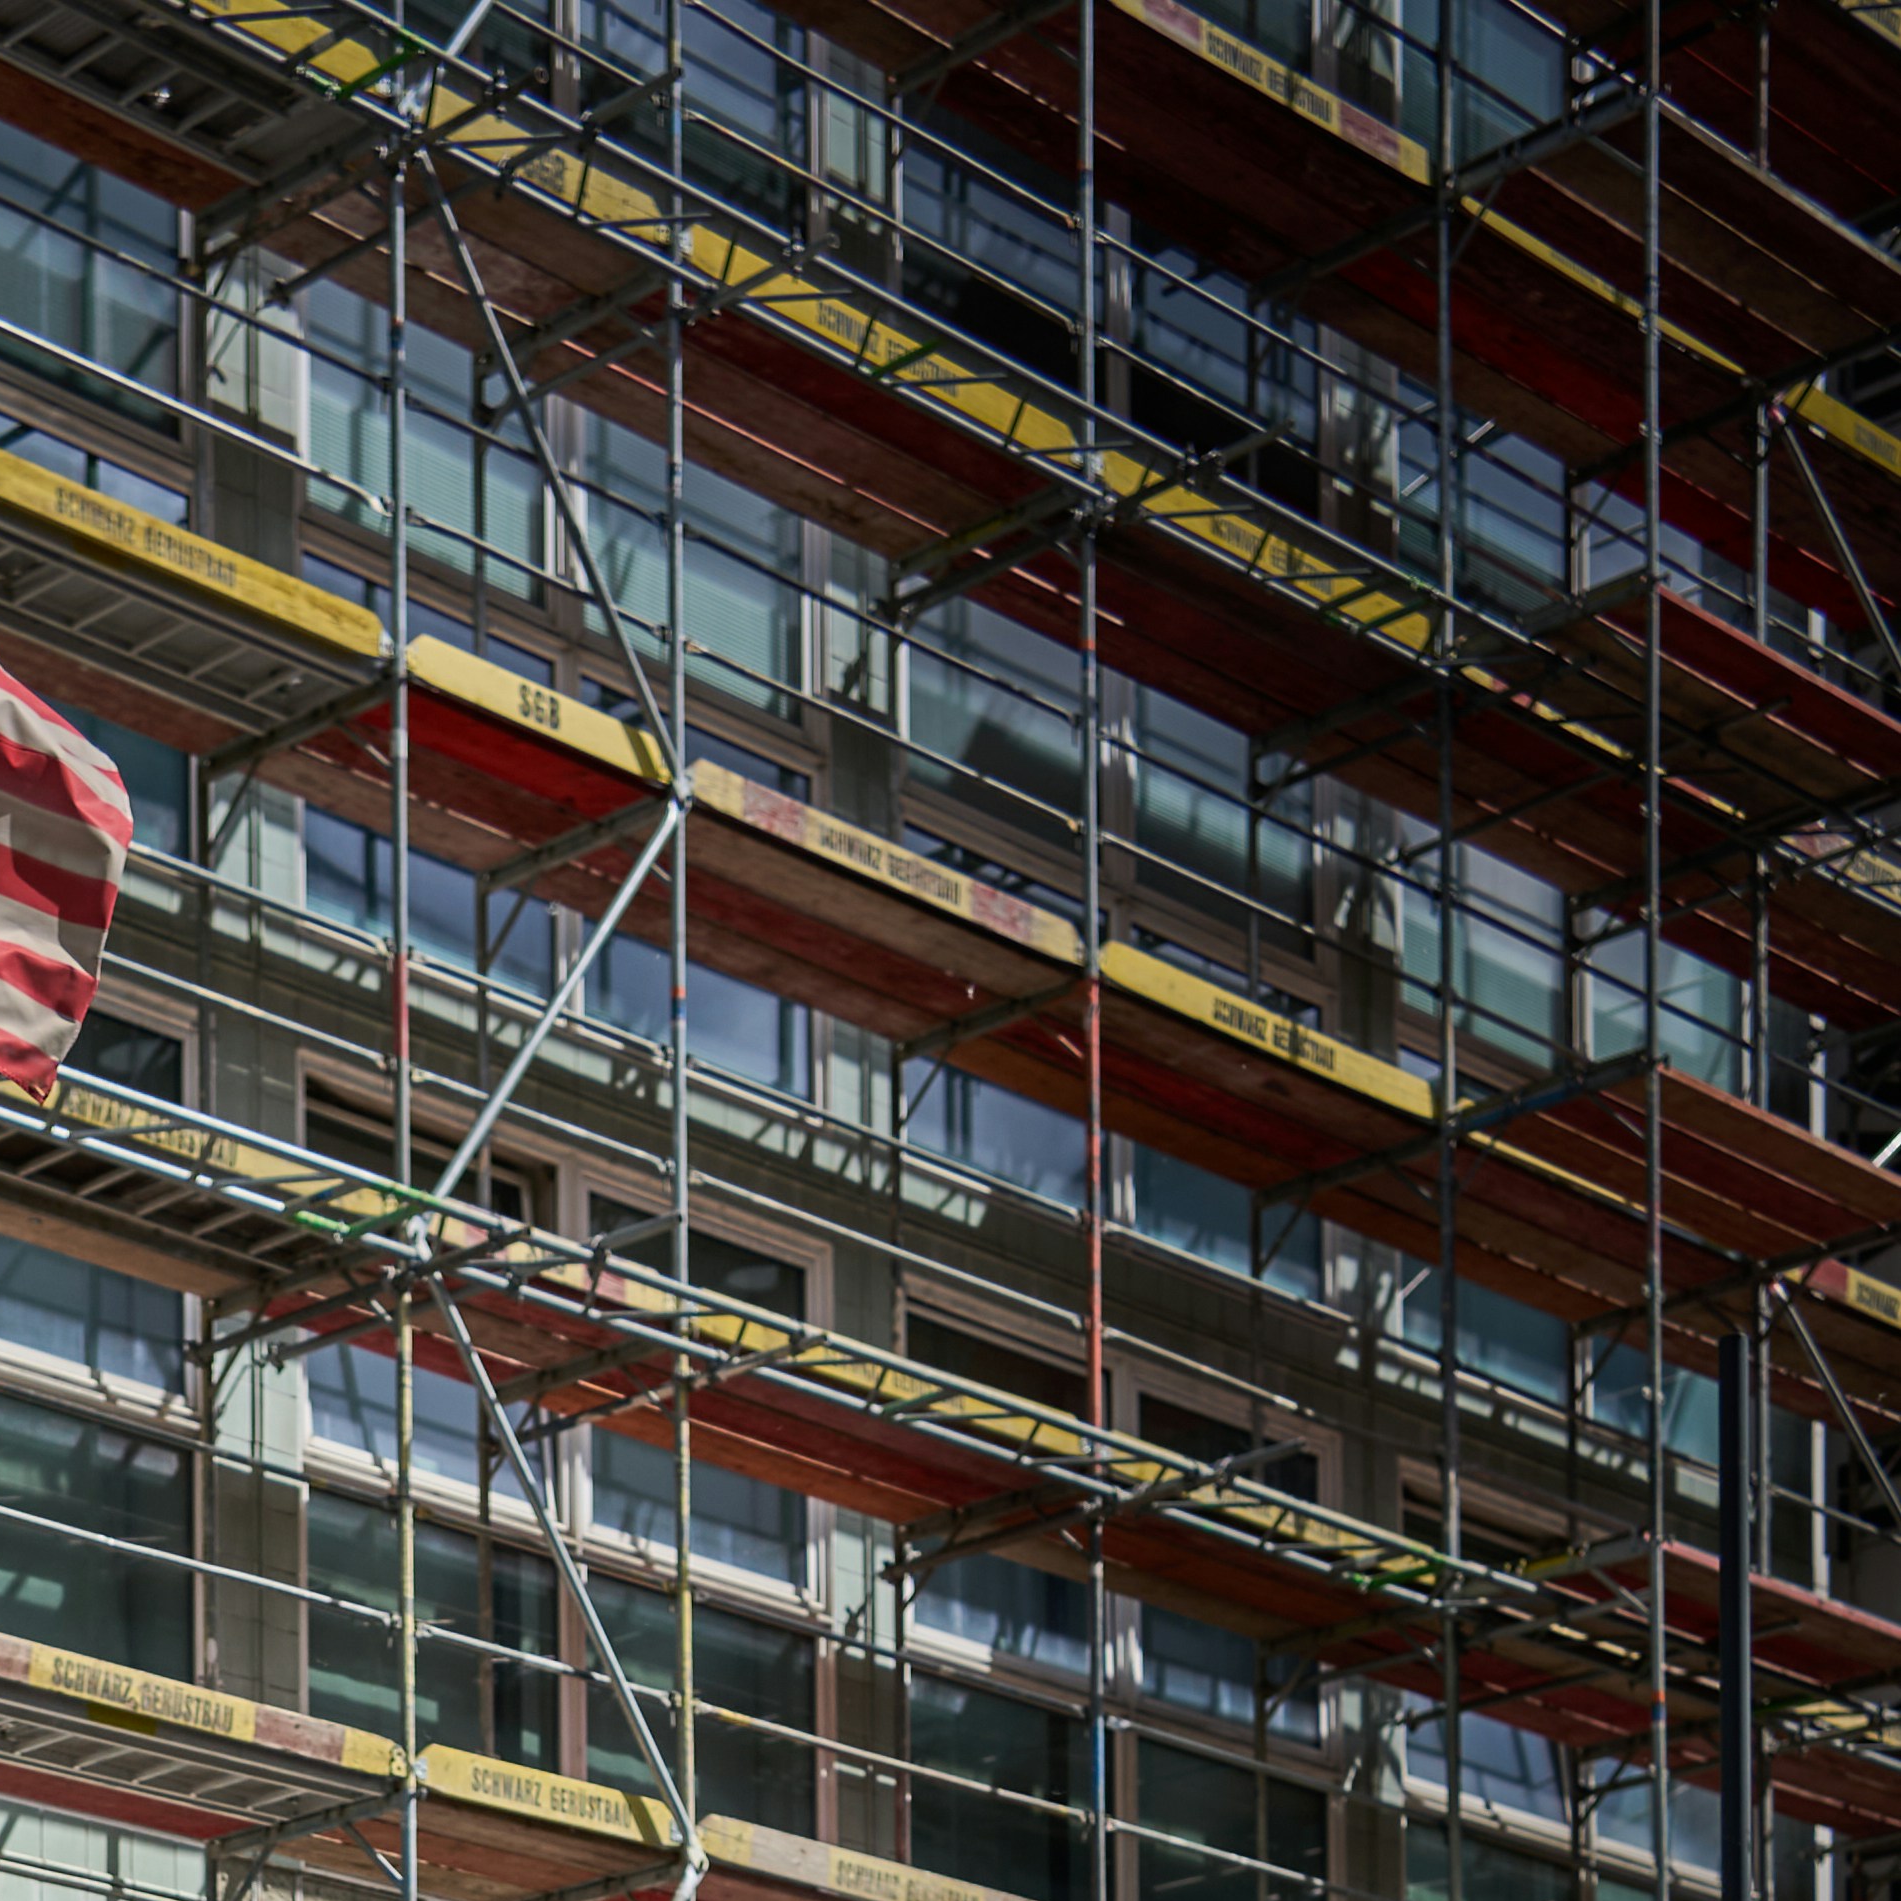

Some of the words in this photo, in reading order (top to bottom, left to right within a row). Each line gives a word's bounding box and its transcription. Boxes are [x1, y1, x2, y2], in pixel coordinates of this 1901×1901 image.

[50, 1656, 132, 1703] SCHWARZ
[138, 1681, 235, 1734] GERÜSTBAU
[470, 1768, 541, 1809] SCHWARZ
[548, 1789, 632, 1830] GERÜSTBAU
